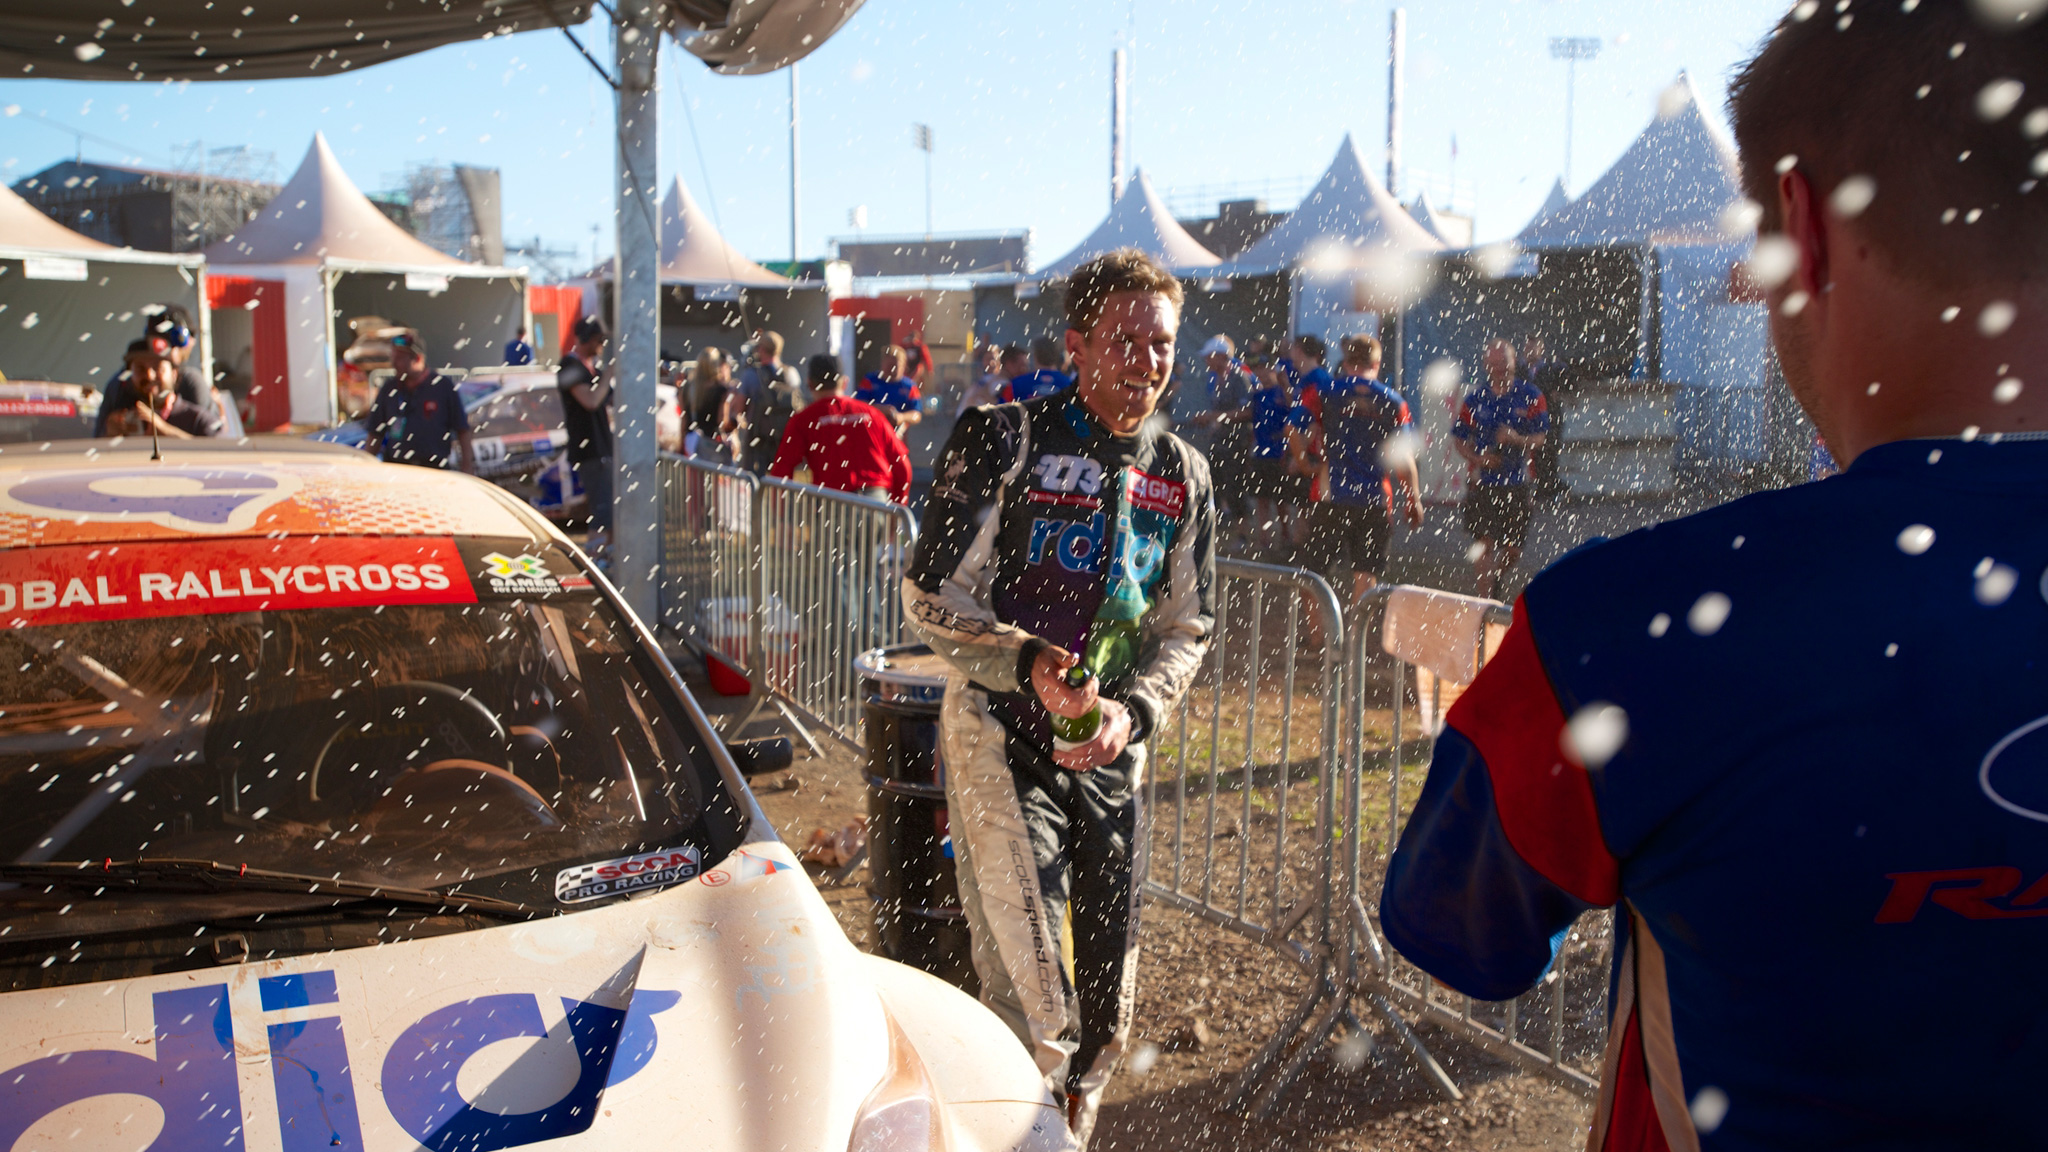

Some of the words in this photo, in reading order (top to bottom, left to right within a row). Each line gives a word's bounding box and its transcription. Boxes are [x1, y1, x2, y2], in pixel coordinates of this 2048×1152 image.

[1026, 512, 1166, 583] rdio
[139, 563, 450, 602] RALLYCROSS
[489, 578, 558, 588] GAMES
[564, 881, 608, 901] PRO
[615, 866, 694, 890] RACING
[597, 852, 694, 880] SCCA
